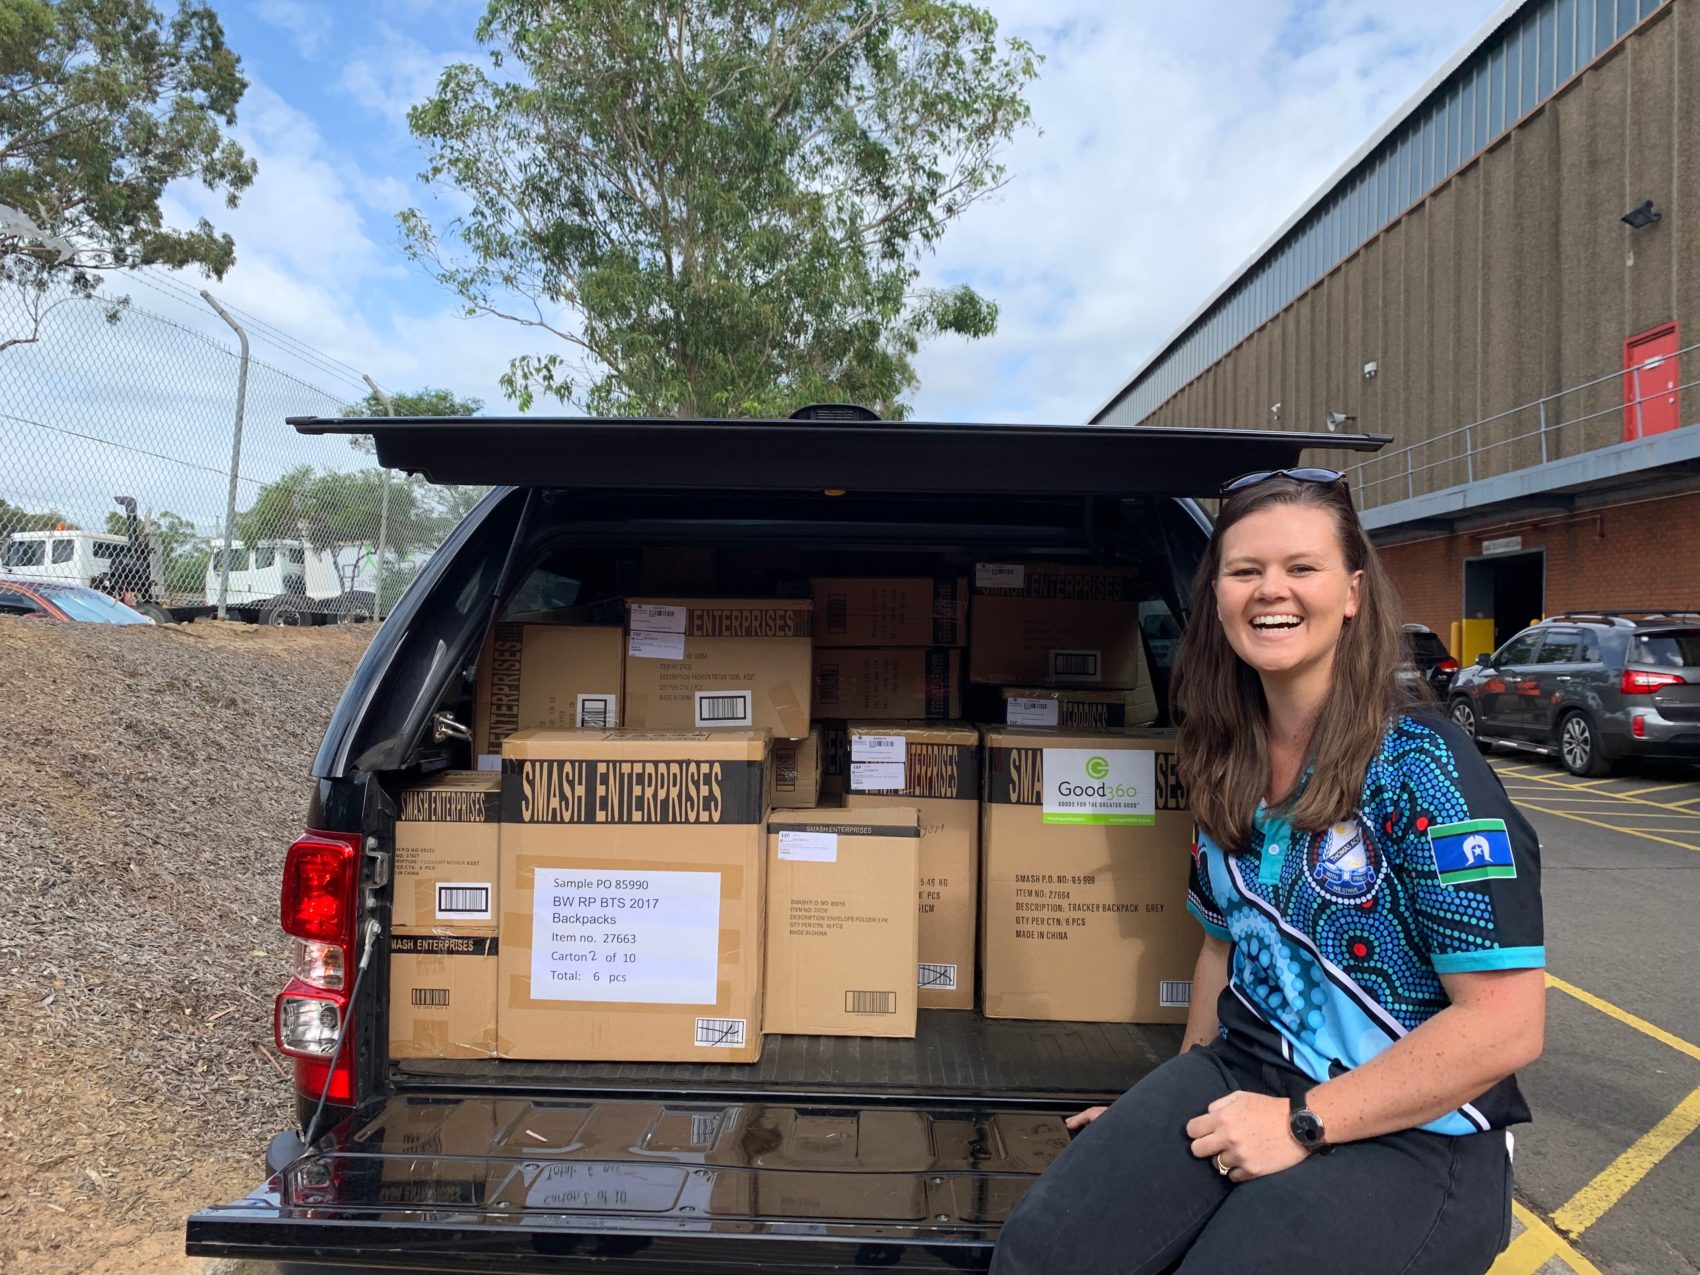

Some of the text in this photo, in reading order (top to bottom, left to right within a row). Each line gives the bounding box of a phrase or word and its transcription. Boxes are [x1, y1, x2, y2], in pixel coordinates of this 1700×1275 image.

[1031, 575, 1123, 601] ENTERPRISES
[693, 609, 794, 637] ENTERPRISES
[489, 641, 522, 743] ENTERPRISES
[1010, 748, 1042, 804] SMA
[522, 760, 722, 823] SMASH ENTERPRISES
[1058, 781, 1137, 801] Good360
[401, 791, 486, 823] SMASH ENTERPRISES
[829, 826, 872, 834] ENTERPRISES
[553, 878, 649, 890] Sample PO 85990
[938, 878, 948, 887] KG
[1016, 874, 1040, 882] SMASH
[1057, 876, 1070, 884] NO:
[928, 891, 940, 900] PCS
[1016, 889, 1033, 897] ITEM
[1034, 890, 1046, 898] NO:
[553, 896, 659, 909] BW RP BTS 2017
[1016, 902, 1164, 912] DESCRIPTION: TRACKER BACKPACK GREY
[552, 913, 617, 926] Backpacks
[1016, 916, 1030, 925] QTY
[1032, 917, 1044, 926] PER
[1046, 917, 1064, 926] CTN:
[1072, 918, 1086, 926] PCS
[552, 933, 636, 944] Item no. 27663
[1016, 930, 1068, 940] MADE IN CHINA
[391, 939, 474, 951] MASH ENTERPRISES
[551, 950, 636, 963] Carton 2 of 10
[550, 970, 627, 984] Total: 6 pcs
